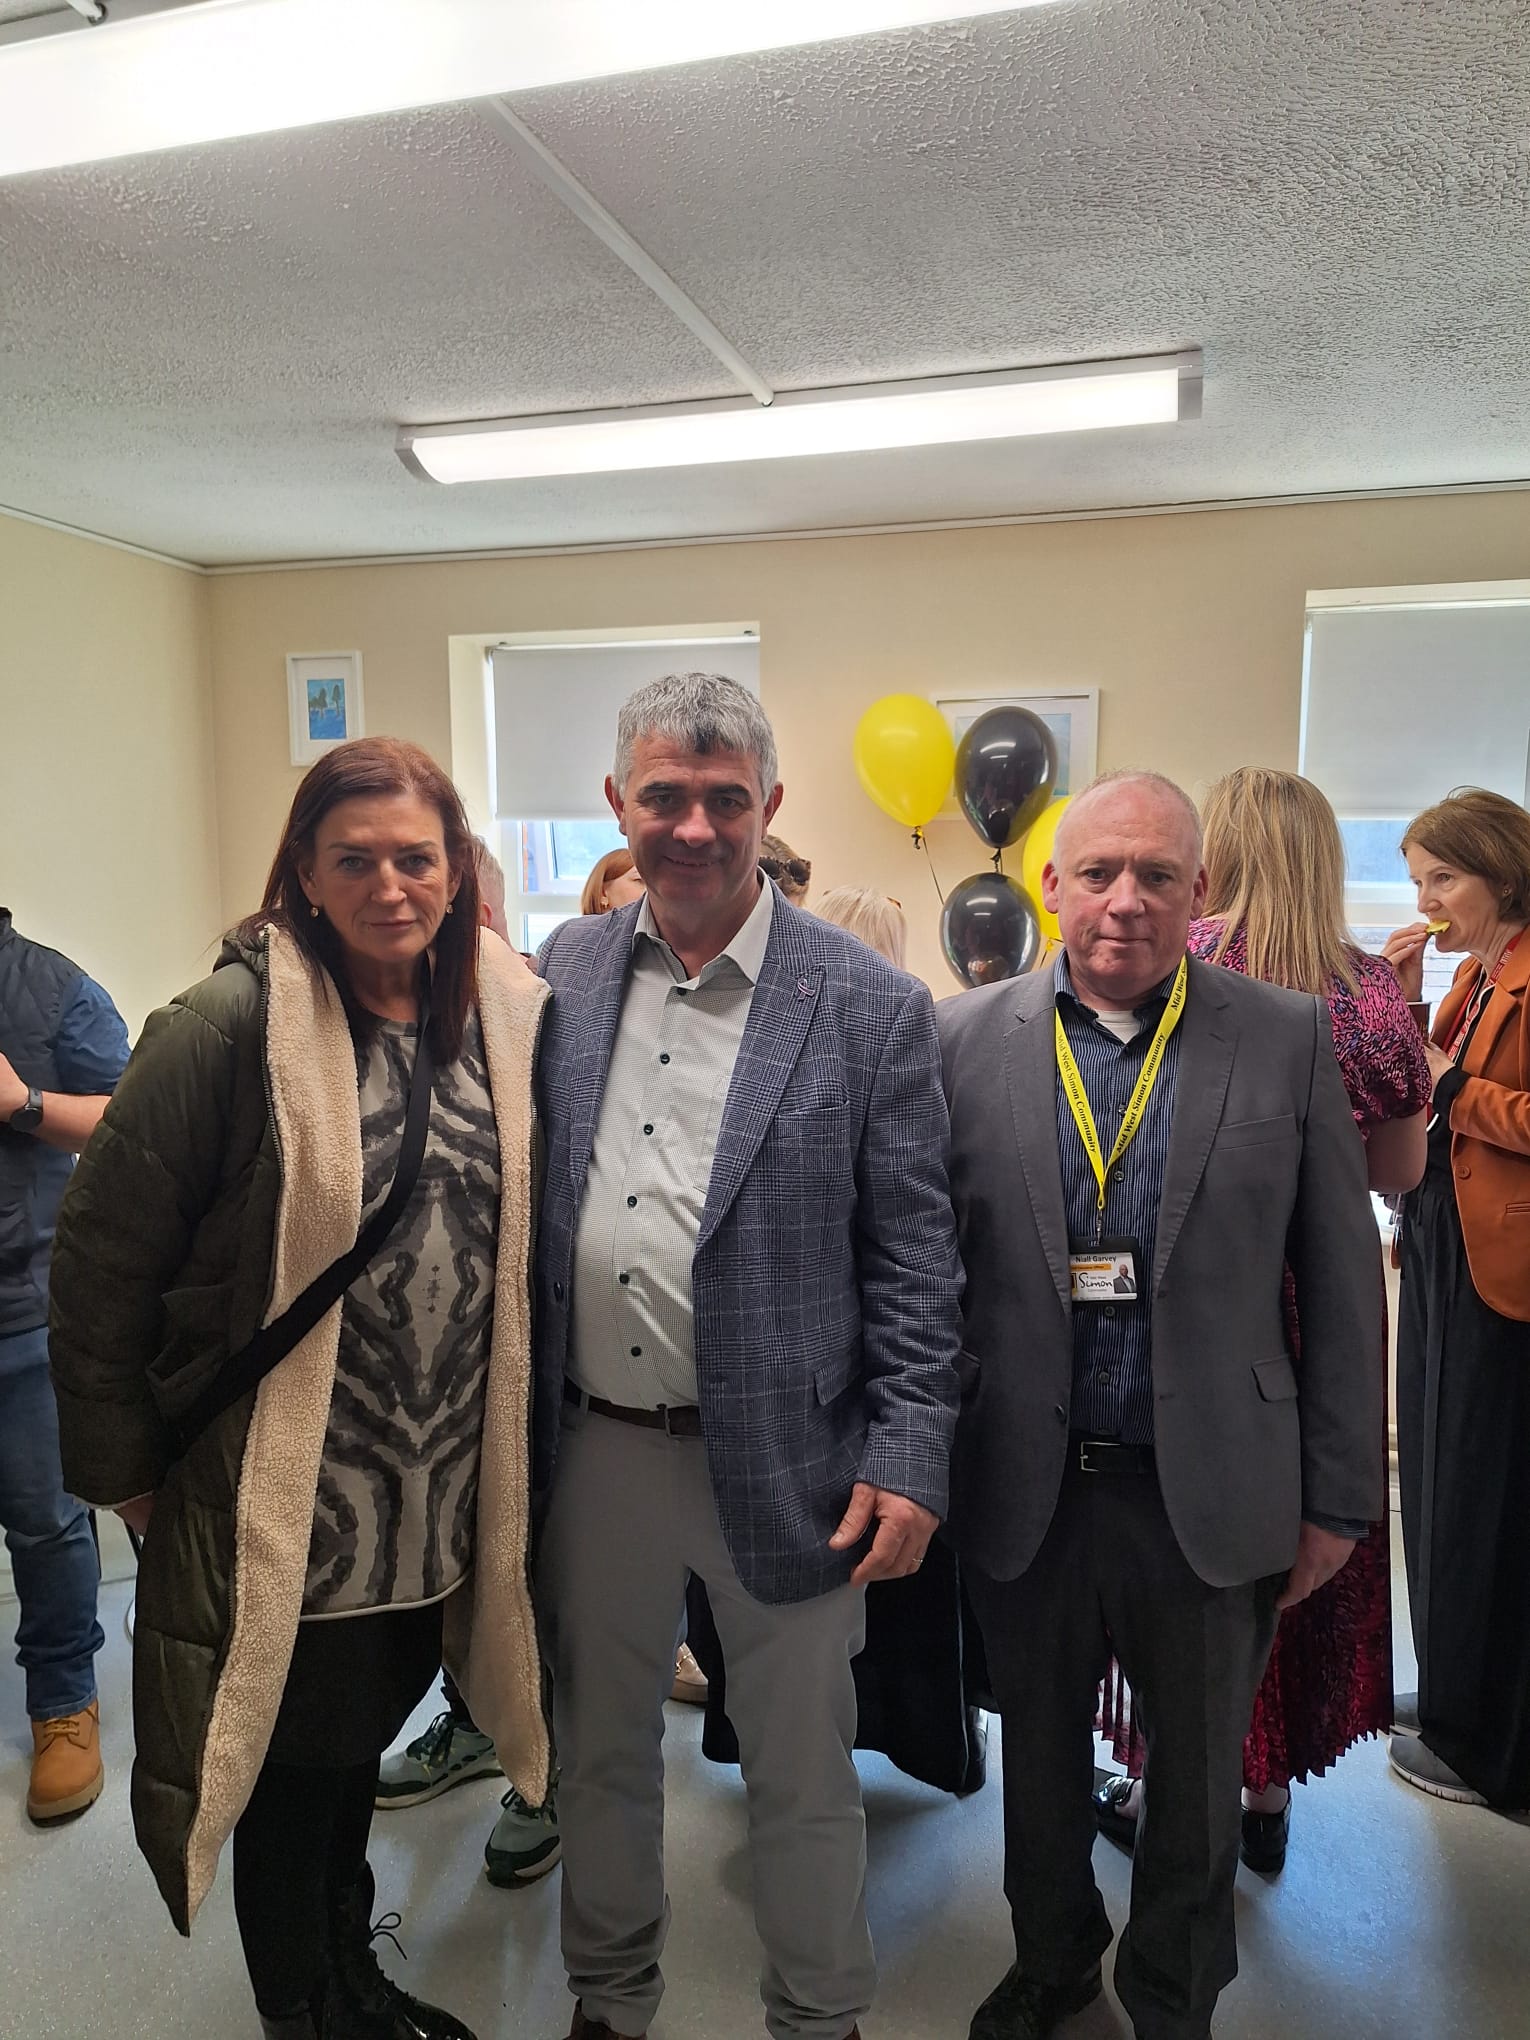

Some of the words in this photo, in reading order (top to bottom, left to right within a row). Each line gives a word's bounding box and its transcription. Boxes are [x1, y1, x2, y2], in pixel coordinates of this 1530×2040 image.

[1057, 1034, 1065, 1052] Mid
[1061, 1052, 1073, 1074] West
[1067, 1073, 1080, 1100] Simon
[1075, 1101, 1097, 1153] Community
[1116, 1135, 1128, 1153] Mid
[1124, 1114, 1137, 1134] West
[1132, 1084, 1148, 1112] Simon
[1142, 1032, 1166, 1081] Community
[1078, 1272, 1113, 1289] Simon
